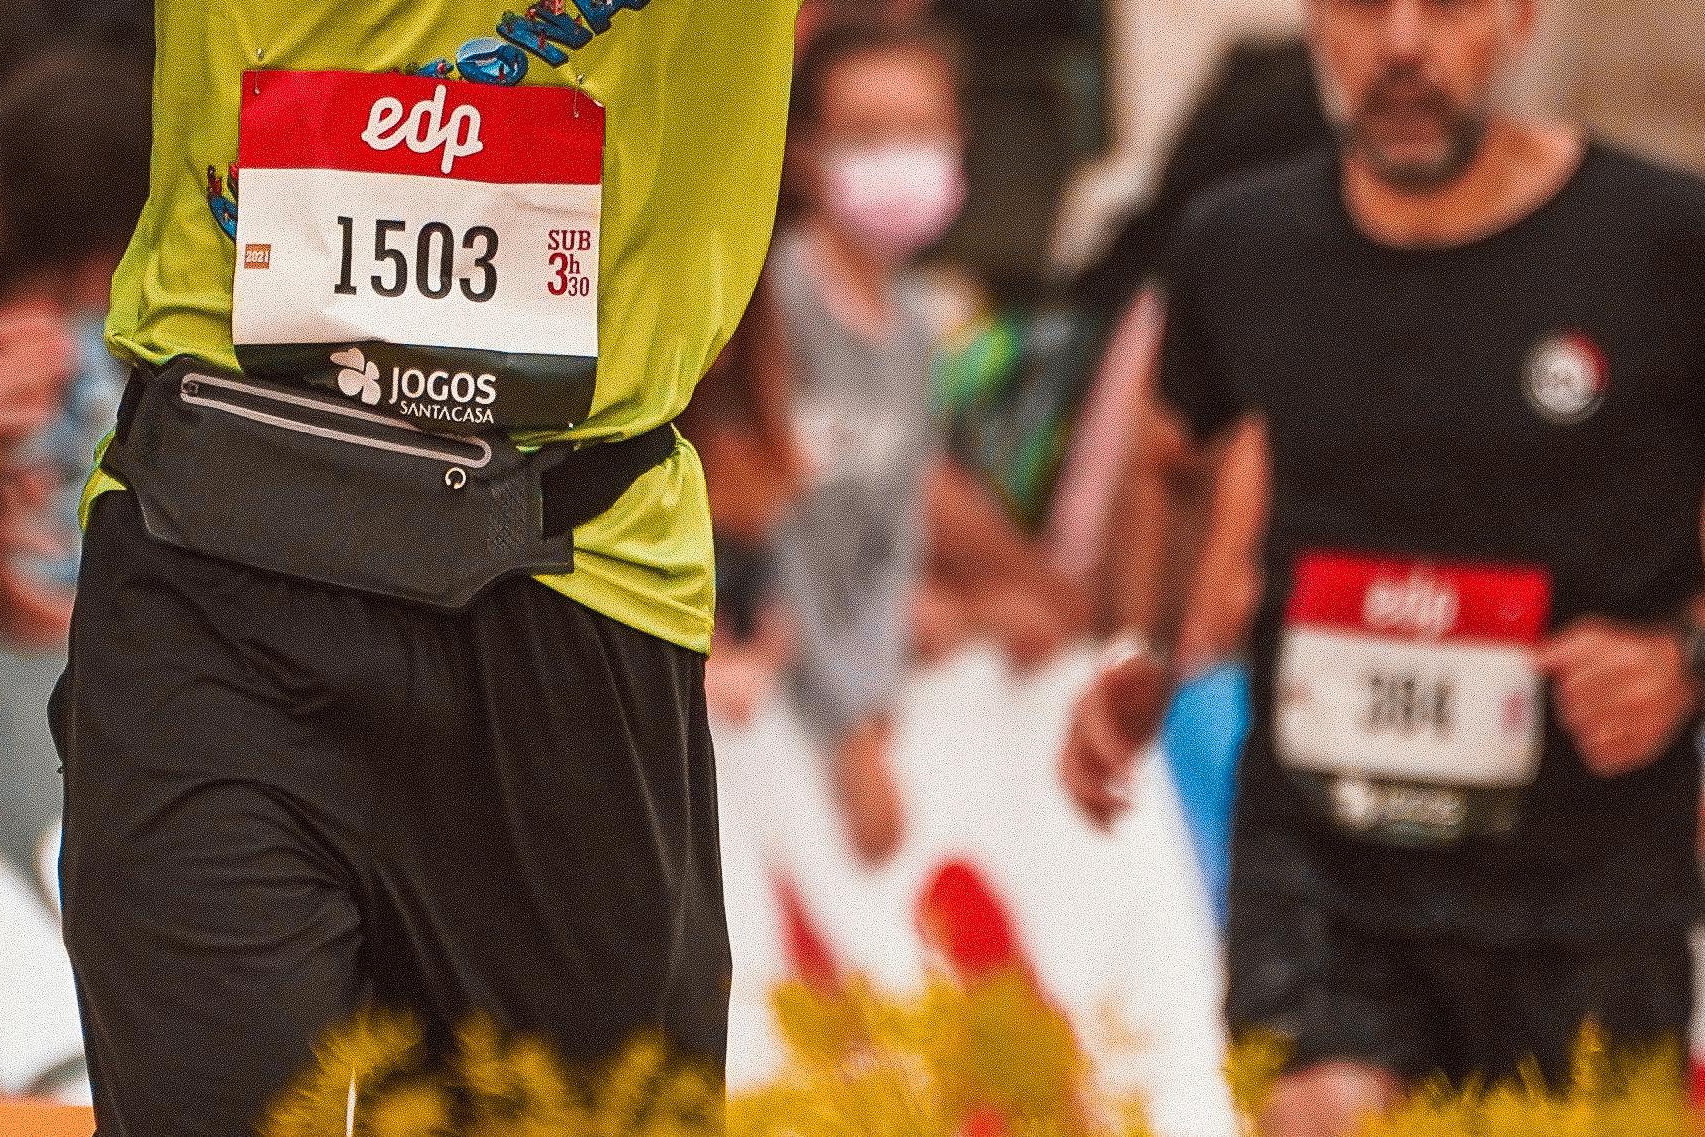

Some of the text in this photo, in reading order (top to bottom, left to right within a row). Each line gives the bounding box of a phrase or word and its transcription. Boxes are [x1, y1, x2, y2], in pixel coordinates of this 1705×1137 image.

[360, 84, 484, 175] edp
[547, 229, 591, 252] SUB
[245, 250, 271, 264] 2021
[333, 215, 499, 303] 1503
[388, 366, 497, 405] JOGOS
[399, 400, 495, 425] SANTACASA
